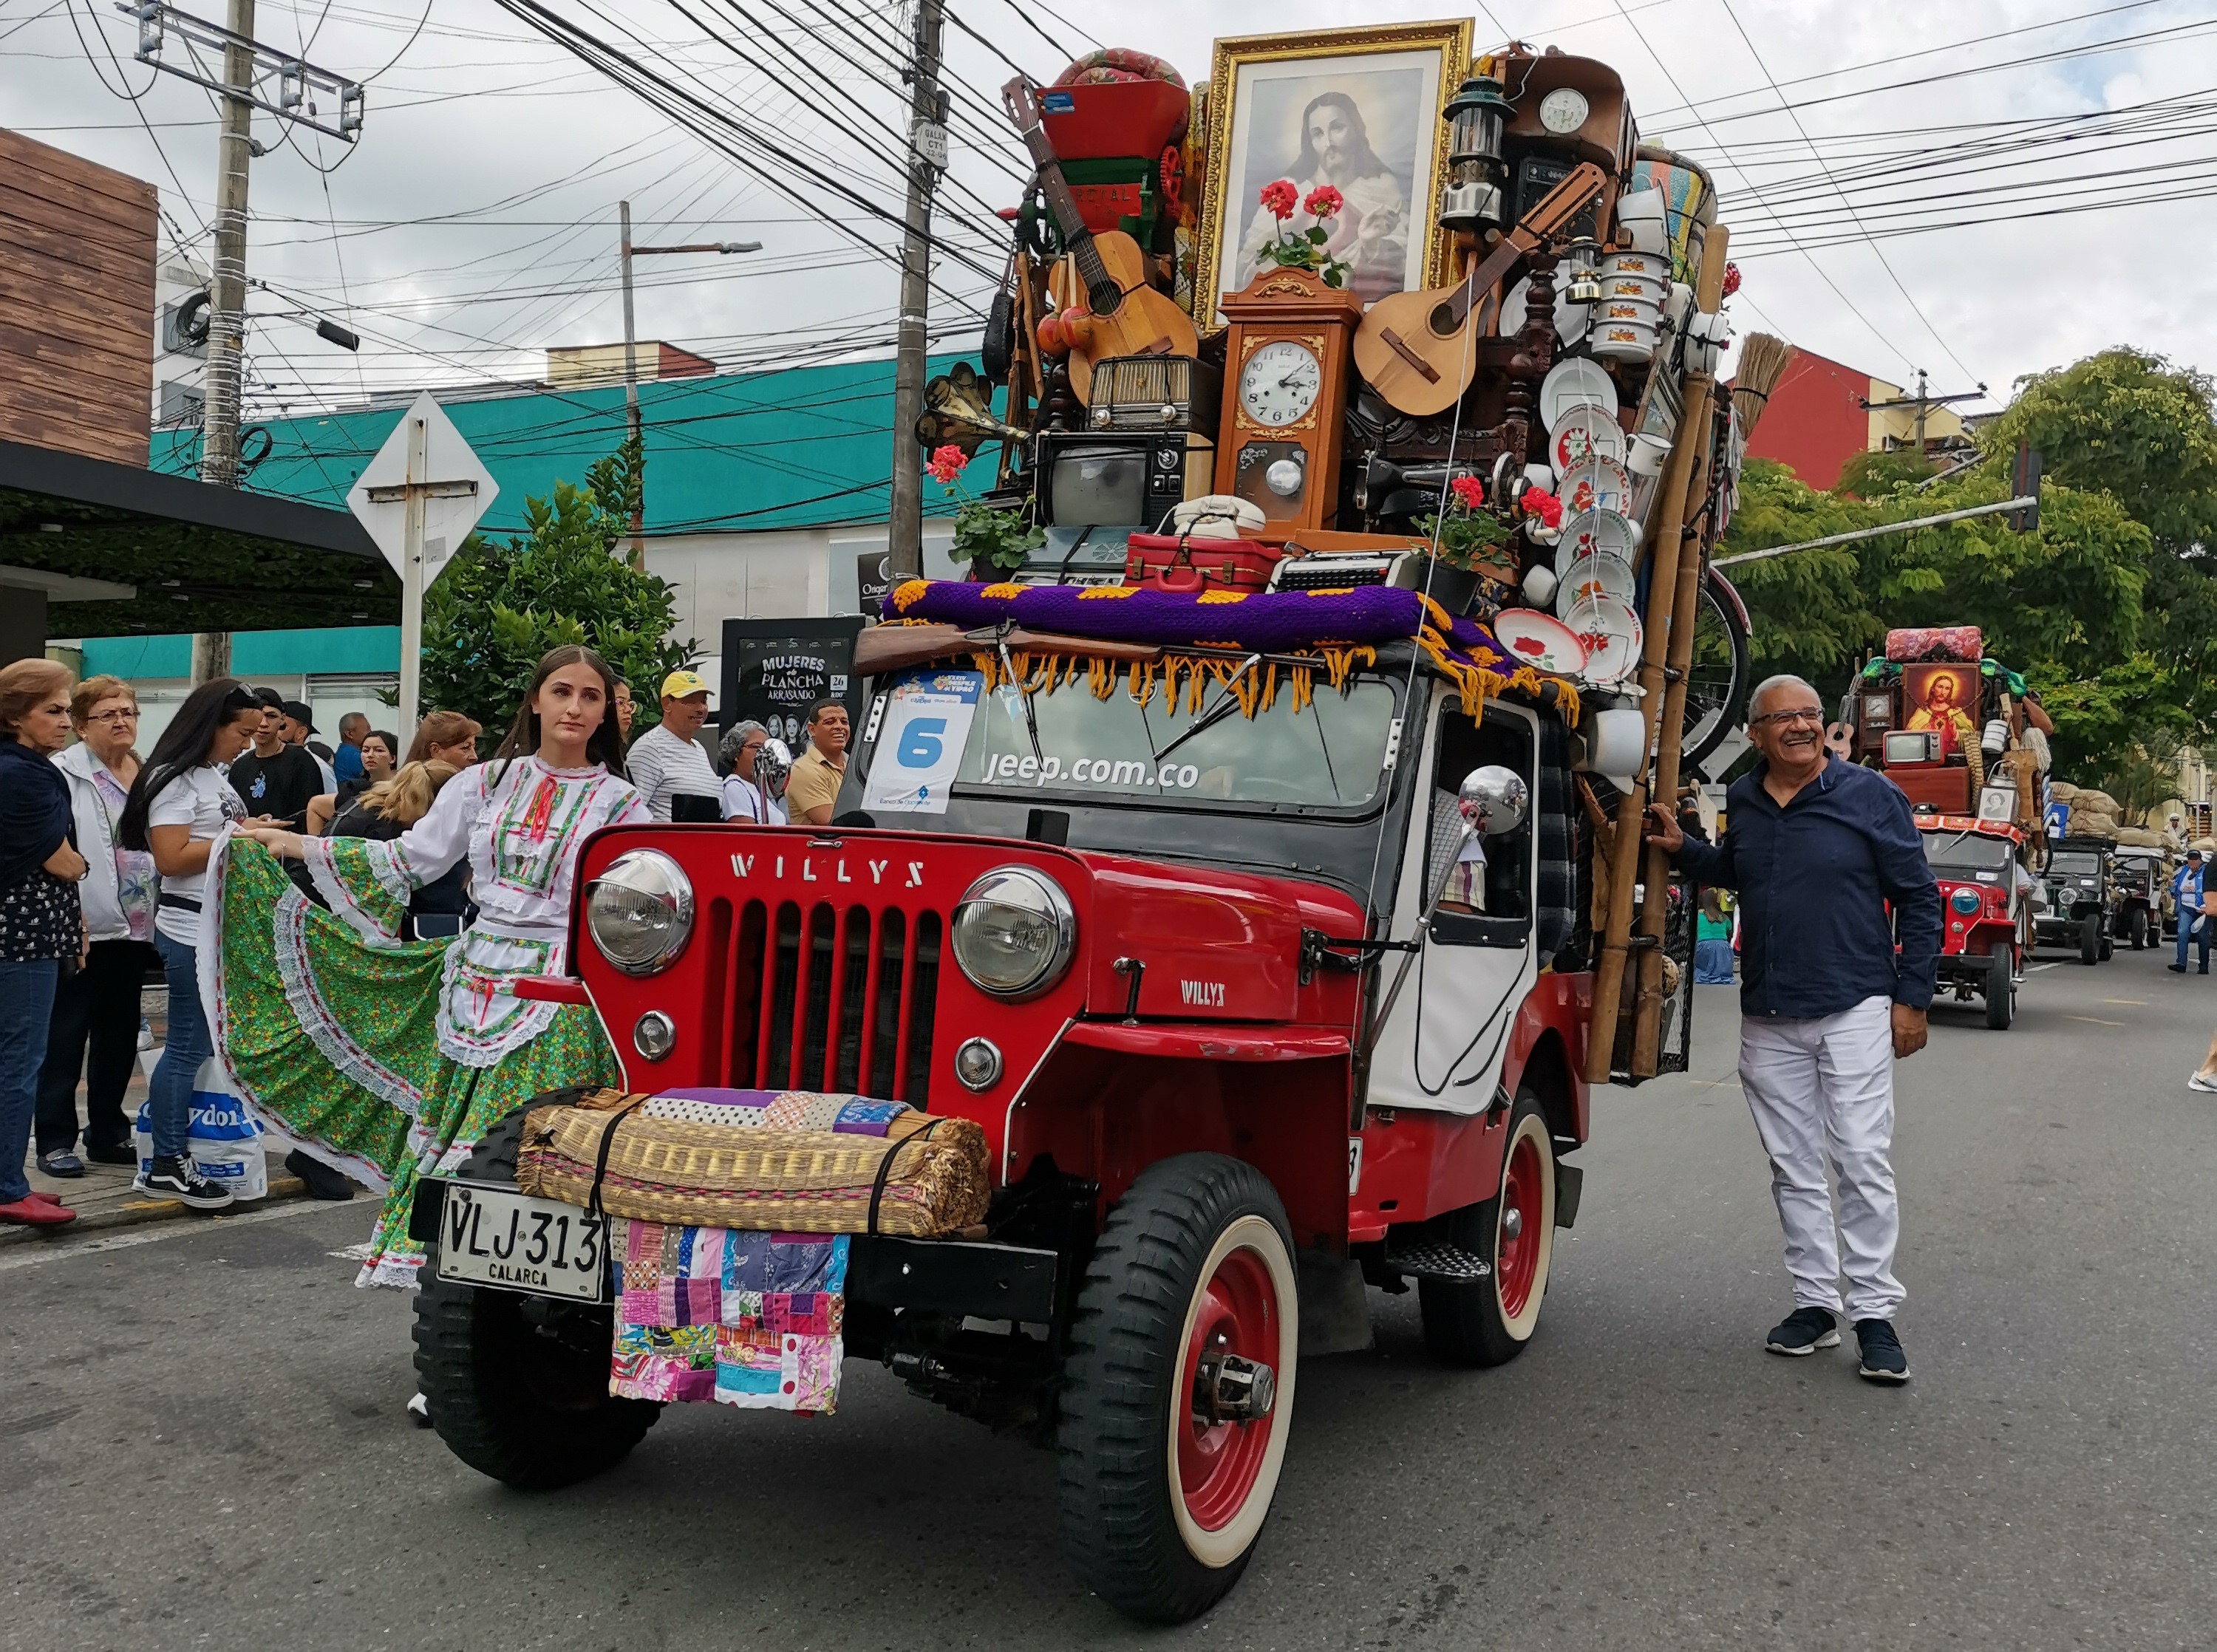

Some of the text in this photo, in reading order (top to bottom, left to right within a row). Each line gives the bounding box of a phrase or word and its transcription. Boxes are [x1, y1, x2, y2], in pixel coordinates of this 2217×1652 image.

[1264, 351, 1273, 360] 11
[1280, 348, 1292, 356] 12
[1253, 361, 1263, 372] 10
[1307, 364, 1316, 373] 2
[1247, 378, 1256, 387] 9
[1307, 380, 1317, 390] 3
[1248, 393, 1258, 403] 8
[1300, 396, 1308, 406] 4
[1258, 406, 1268, 417] 7
[1273, 412, 1281, 421] 6
[1288, 408, 1298, 417] 5
[762, 655, 825, 672] MUJERES
[761, 673, 824, 689] PLANCHA
[833, 677, 844, 686] 26
[768, 690, 816, 700] ARRASANDO
[896, 717, 947, 768] 6
[730, 853, 924, 887] WILLYS
[1180, 979, 1225, 1007] WILLYS
[488, 1263, 548, 1287] CALARCA
